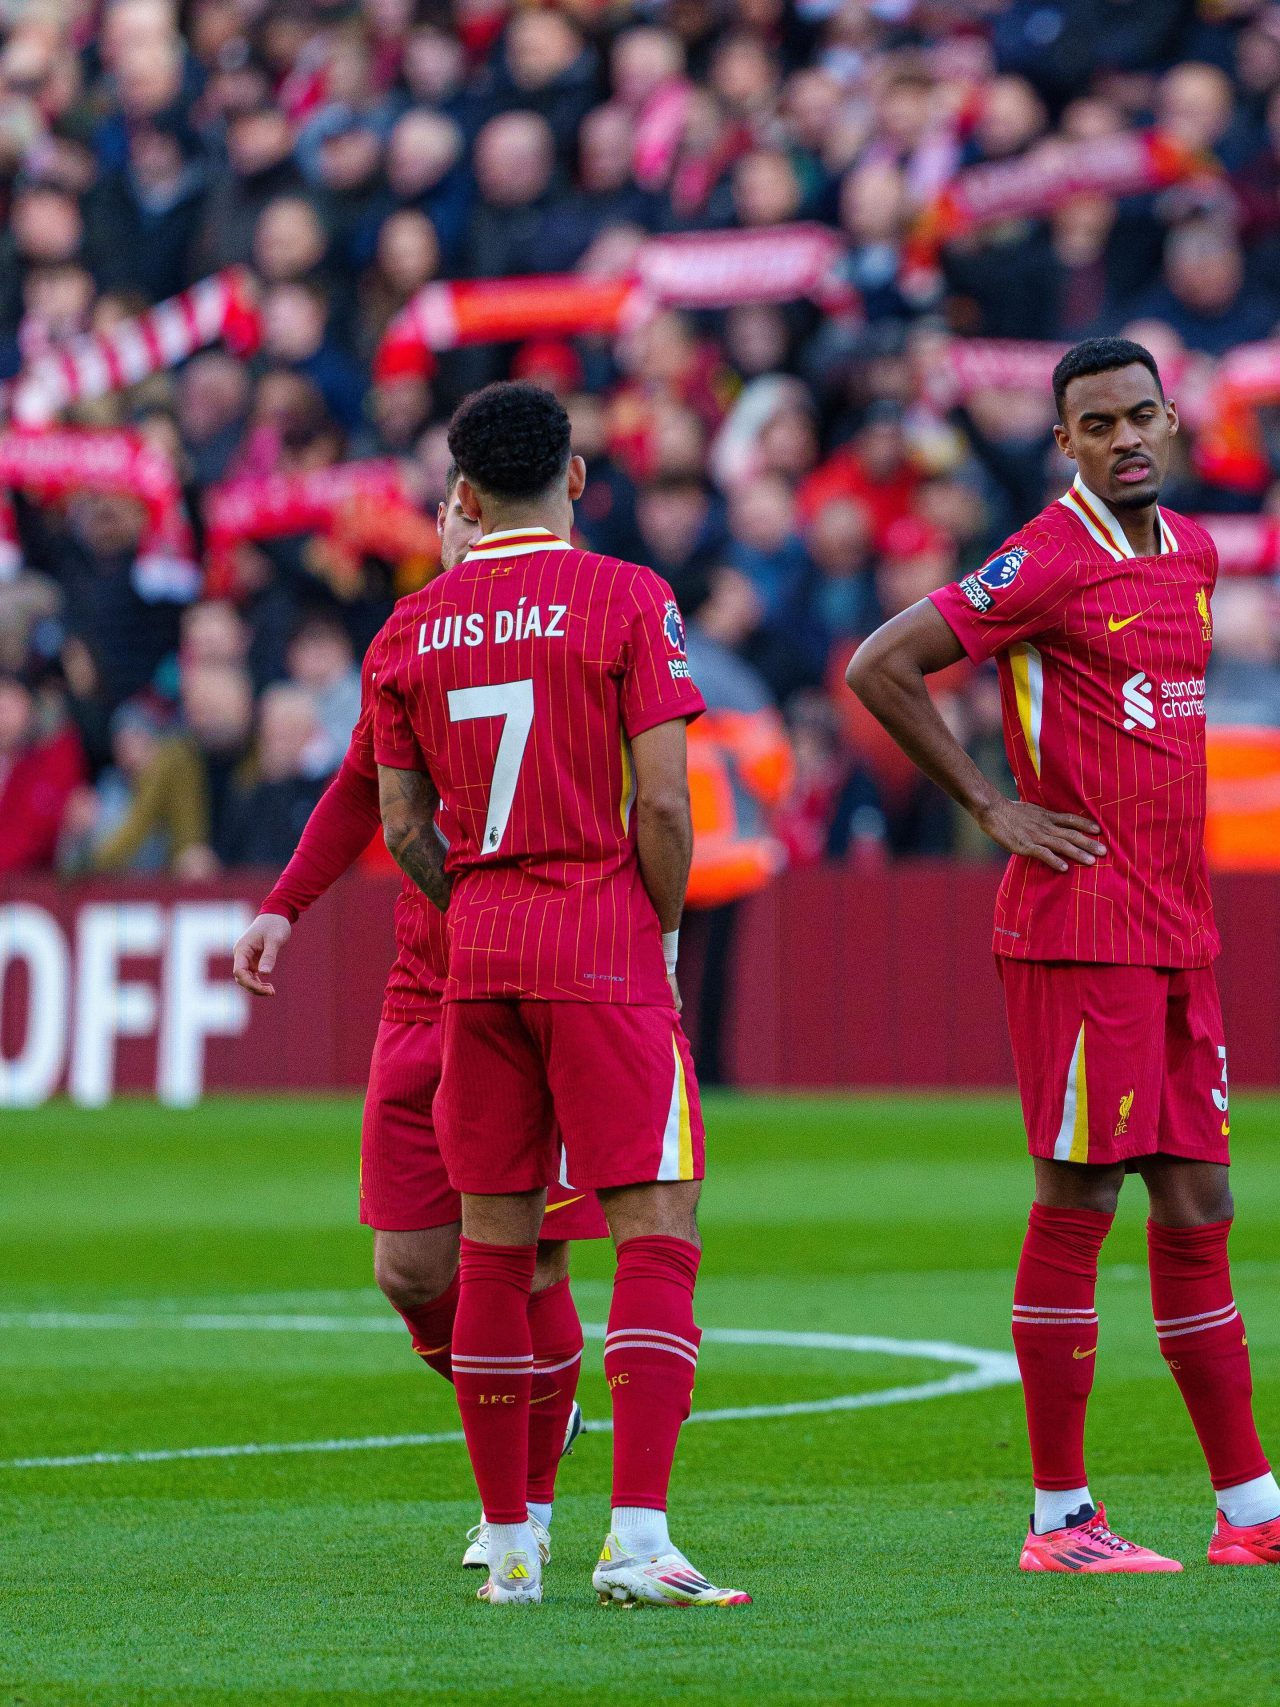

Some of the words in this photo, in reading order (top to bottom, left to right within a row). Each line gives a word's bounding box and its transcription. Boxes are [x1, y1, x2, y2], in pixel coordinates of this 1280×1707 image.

[417, 613, 485, 655] LUIS
[494, 596, 567, 644] DÍAZ
[447, 678, 535, 856] 7
[0, 900, 254, 1110] OFF
[479, 1394, 516, 1404] LFC
